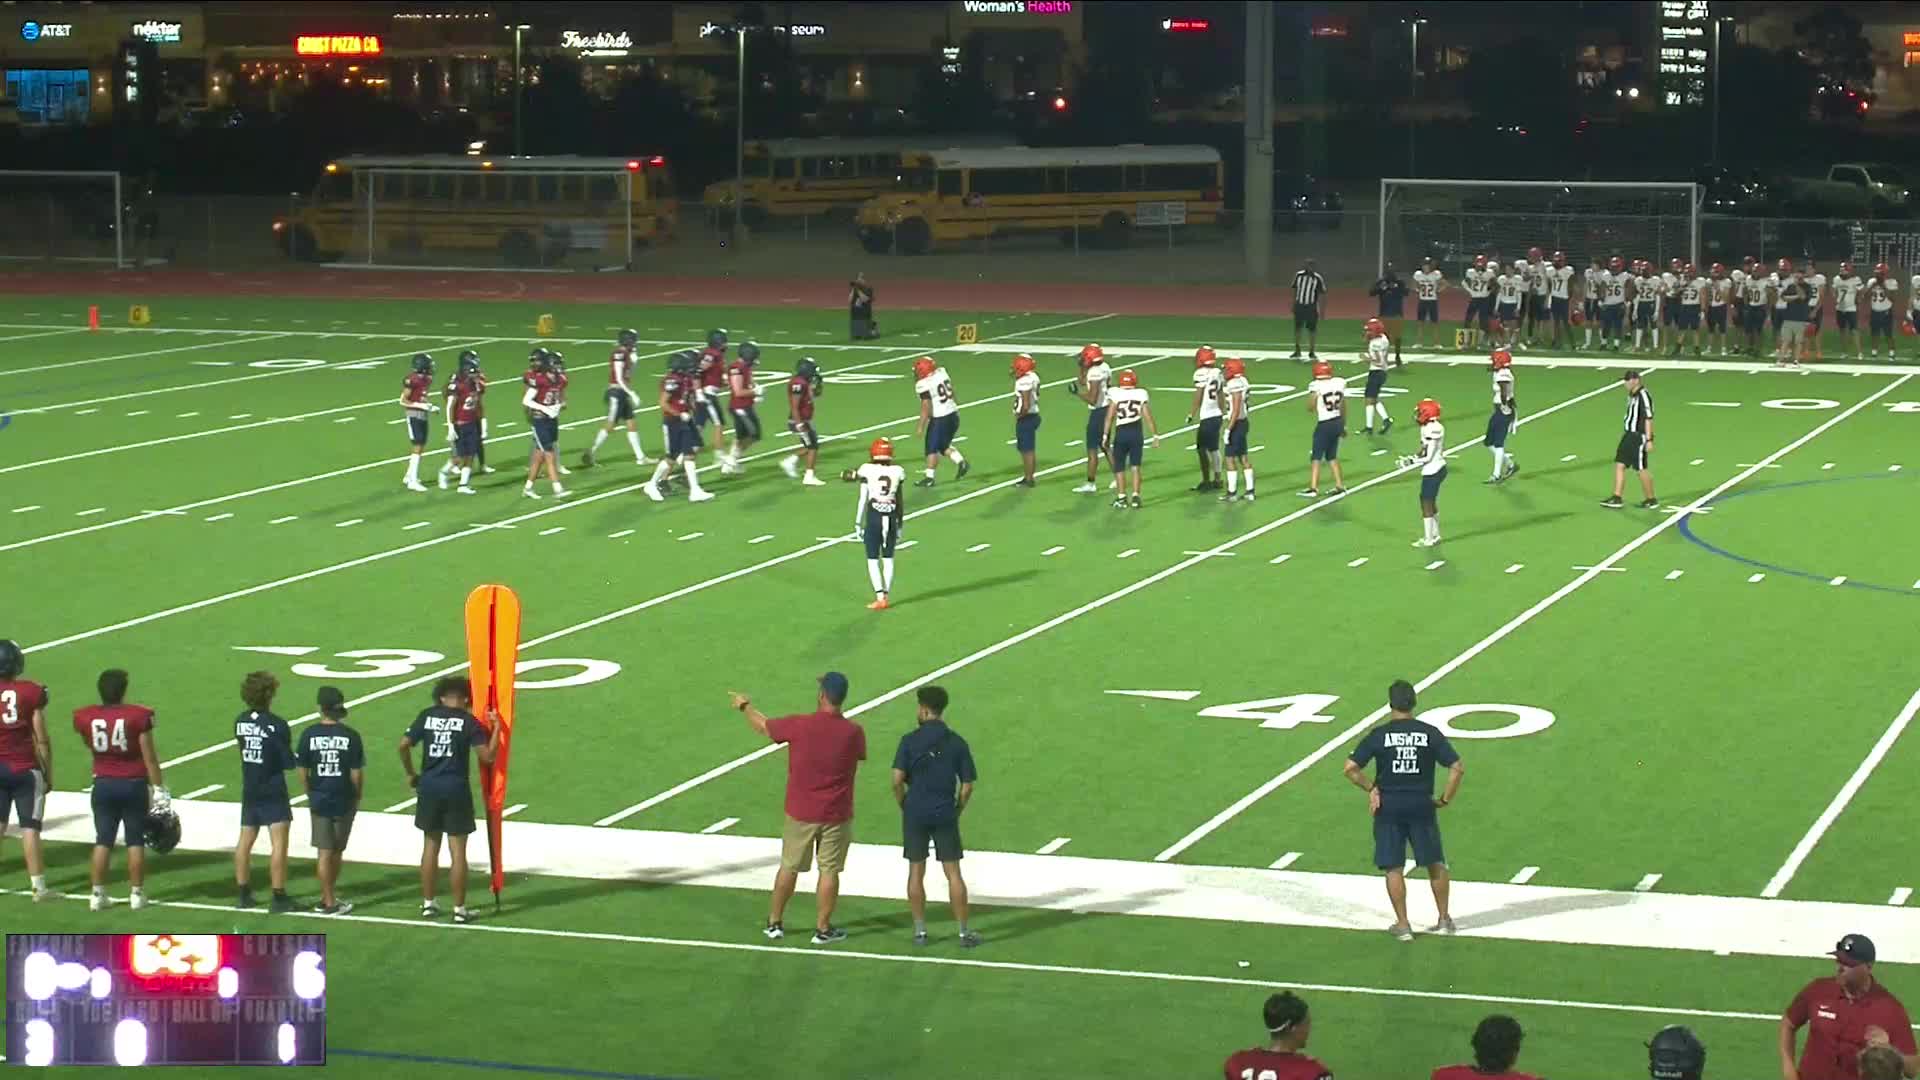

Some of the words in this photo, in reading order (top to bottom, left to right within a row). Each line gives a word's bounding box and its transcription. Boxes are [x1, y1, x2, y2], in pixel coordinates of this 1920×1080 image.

[964, 1, 1025, 12] Woman's
[1027, 1, 1071, 12] Health
[41, 25, 72, 36] AT&T
[561, 31, 633, 48] Freebirds
[1471, 280, 1487, 292] 27
[959, 326, 974, 341] 20
[1323, 392, 1343, 411] 52
[1117, 400, 1141, 419] 55
[878, 475, 892, 496] 3
[91, 718, 128, 752] 64
[1384, 733, 1428, 747] ANSWER
[310, 735, 349, 750] ANSWER
[242, 750, 263, 763] CALL
[320, 750, 339, 763] THE
[1395, 747, 1417, 760] THE
[317, 763, 342, 776] CALL
[1392, 760, 1419, 773] CALL
